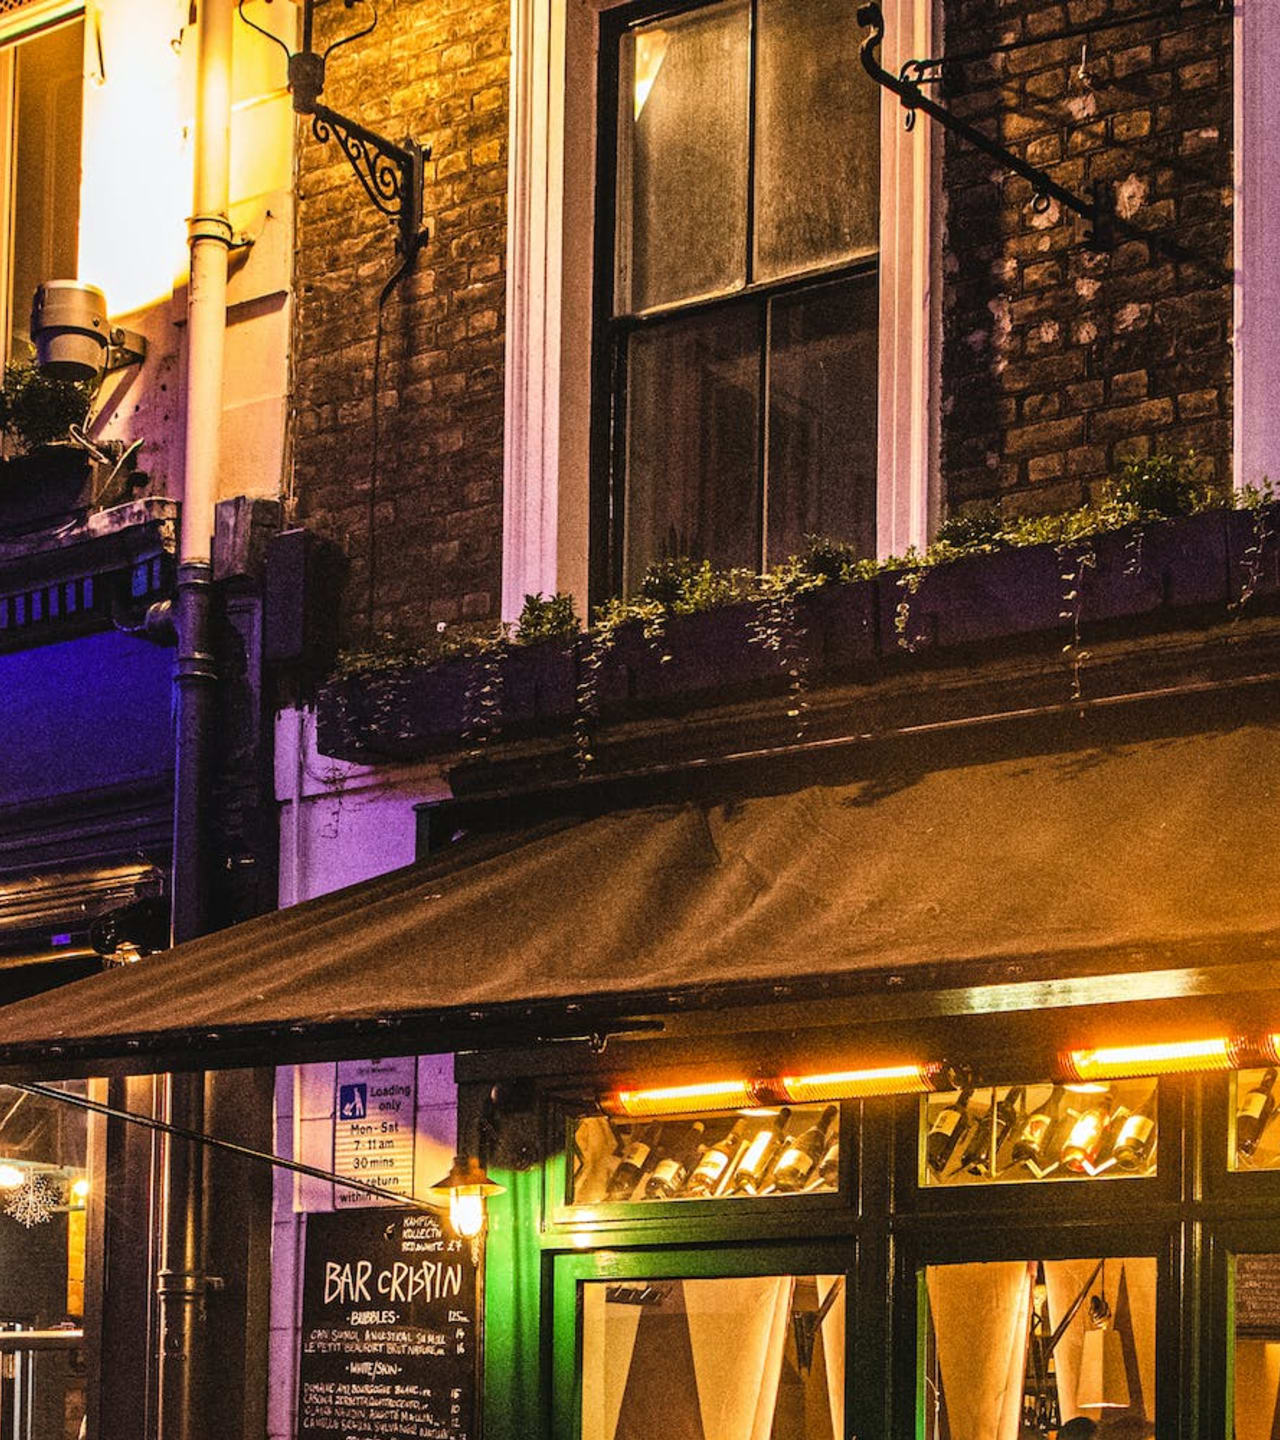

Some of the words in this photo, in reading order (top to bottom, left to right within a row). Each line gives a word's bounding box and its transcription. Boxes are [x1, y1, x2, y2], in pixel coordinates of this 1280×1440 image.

[370, 1085, 411, 1097] Loading
[379, 1100, 401, 1112] only
[353, 1157, 368, 1169] 30
[324, 1260, 372, 1304] BAR
